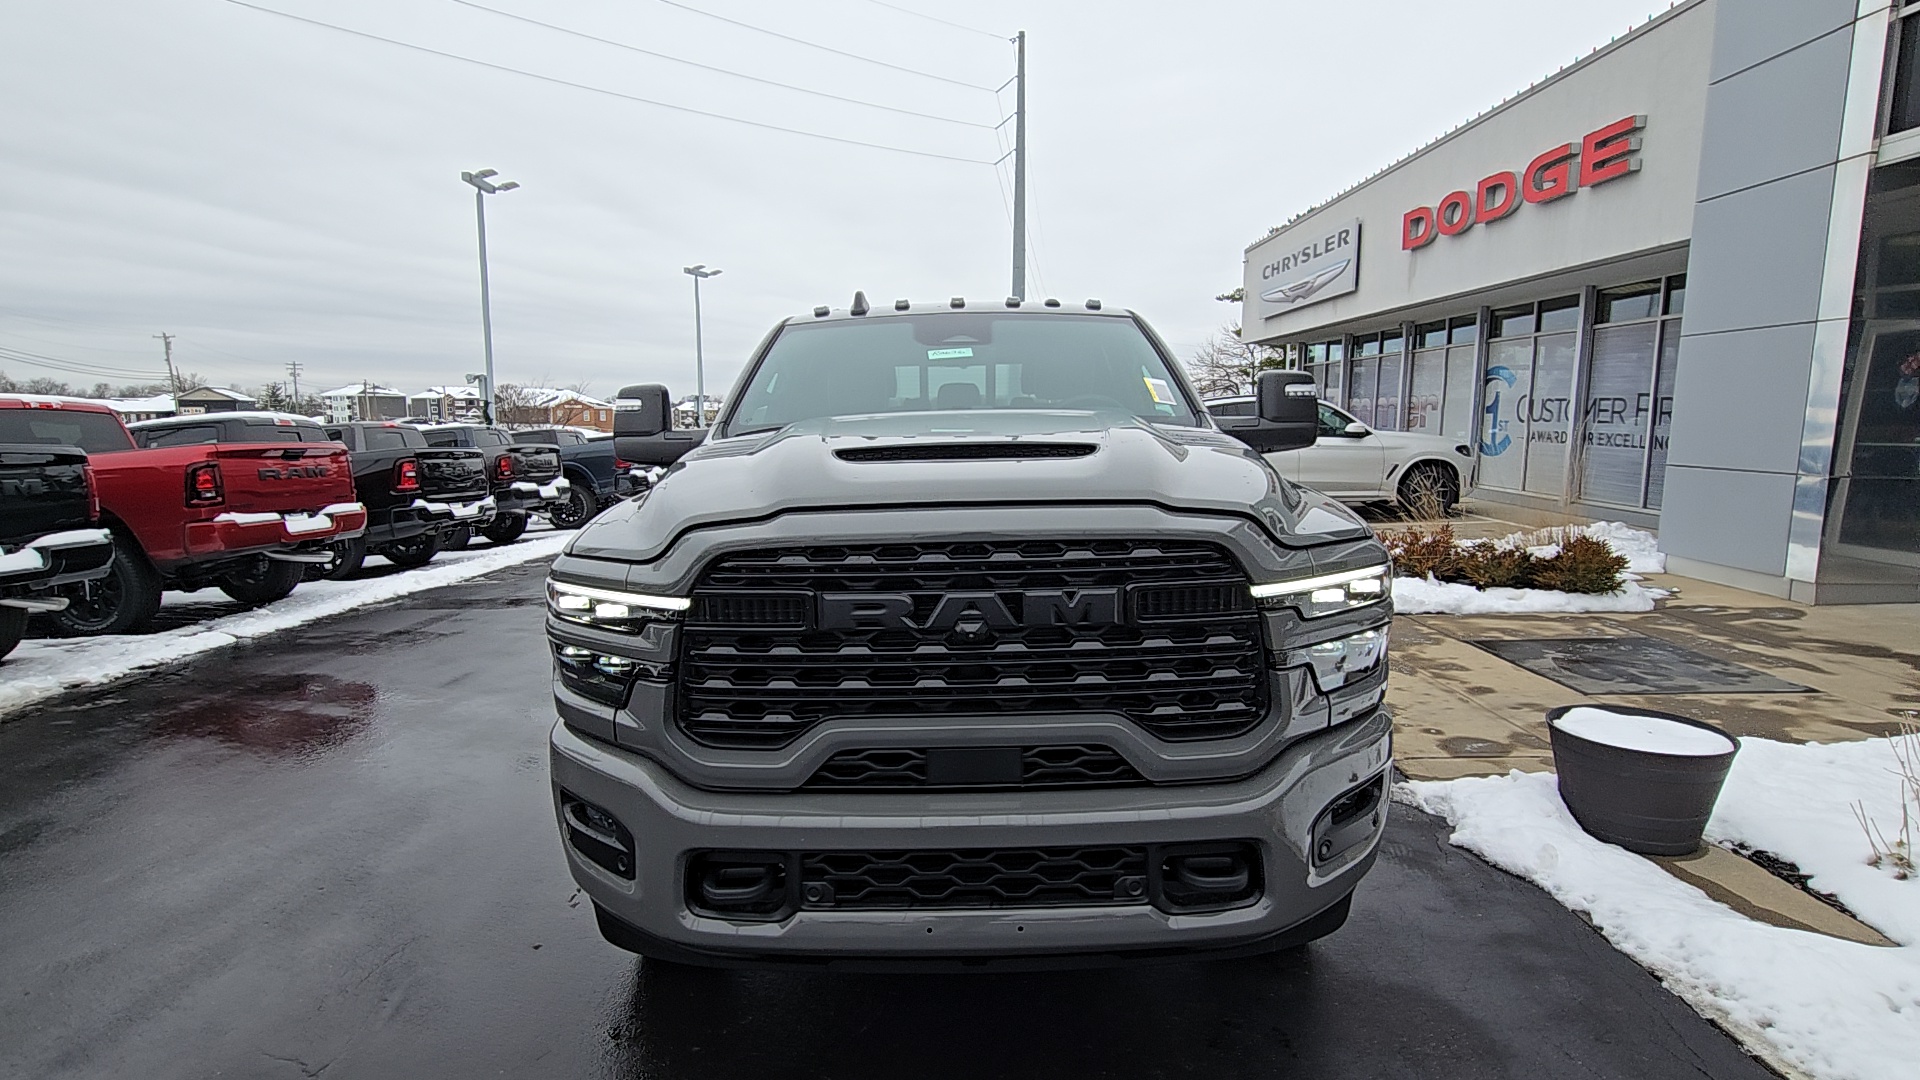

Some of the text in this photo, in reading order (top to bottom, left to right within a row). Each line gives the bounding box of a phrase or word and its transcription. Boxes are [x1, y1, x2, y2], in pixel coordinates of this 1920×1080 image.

[1402, 114, 1647, 251] DODGE
[1261, 228, 1351, 280] CHRYSLER
[1515, 394, 1628, 425] CUSTMER
[257, 465, 328, 481] RAM
[820, 589, 1119, 629] RAM
